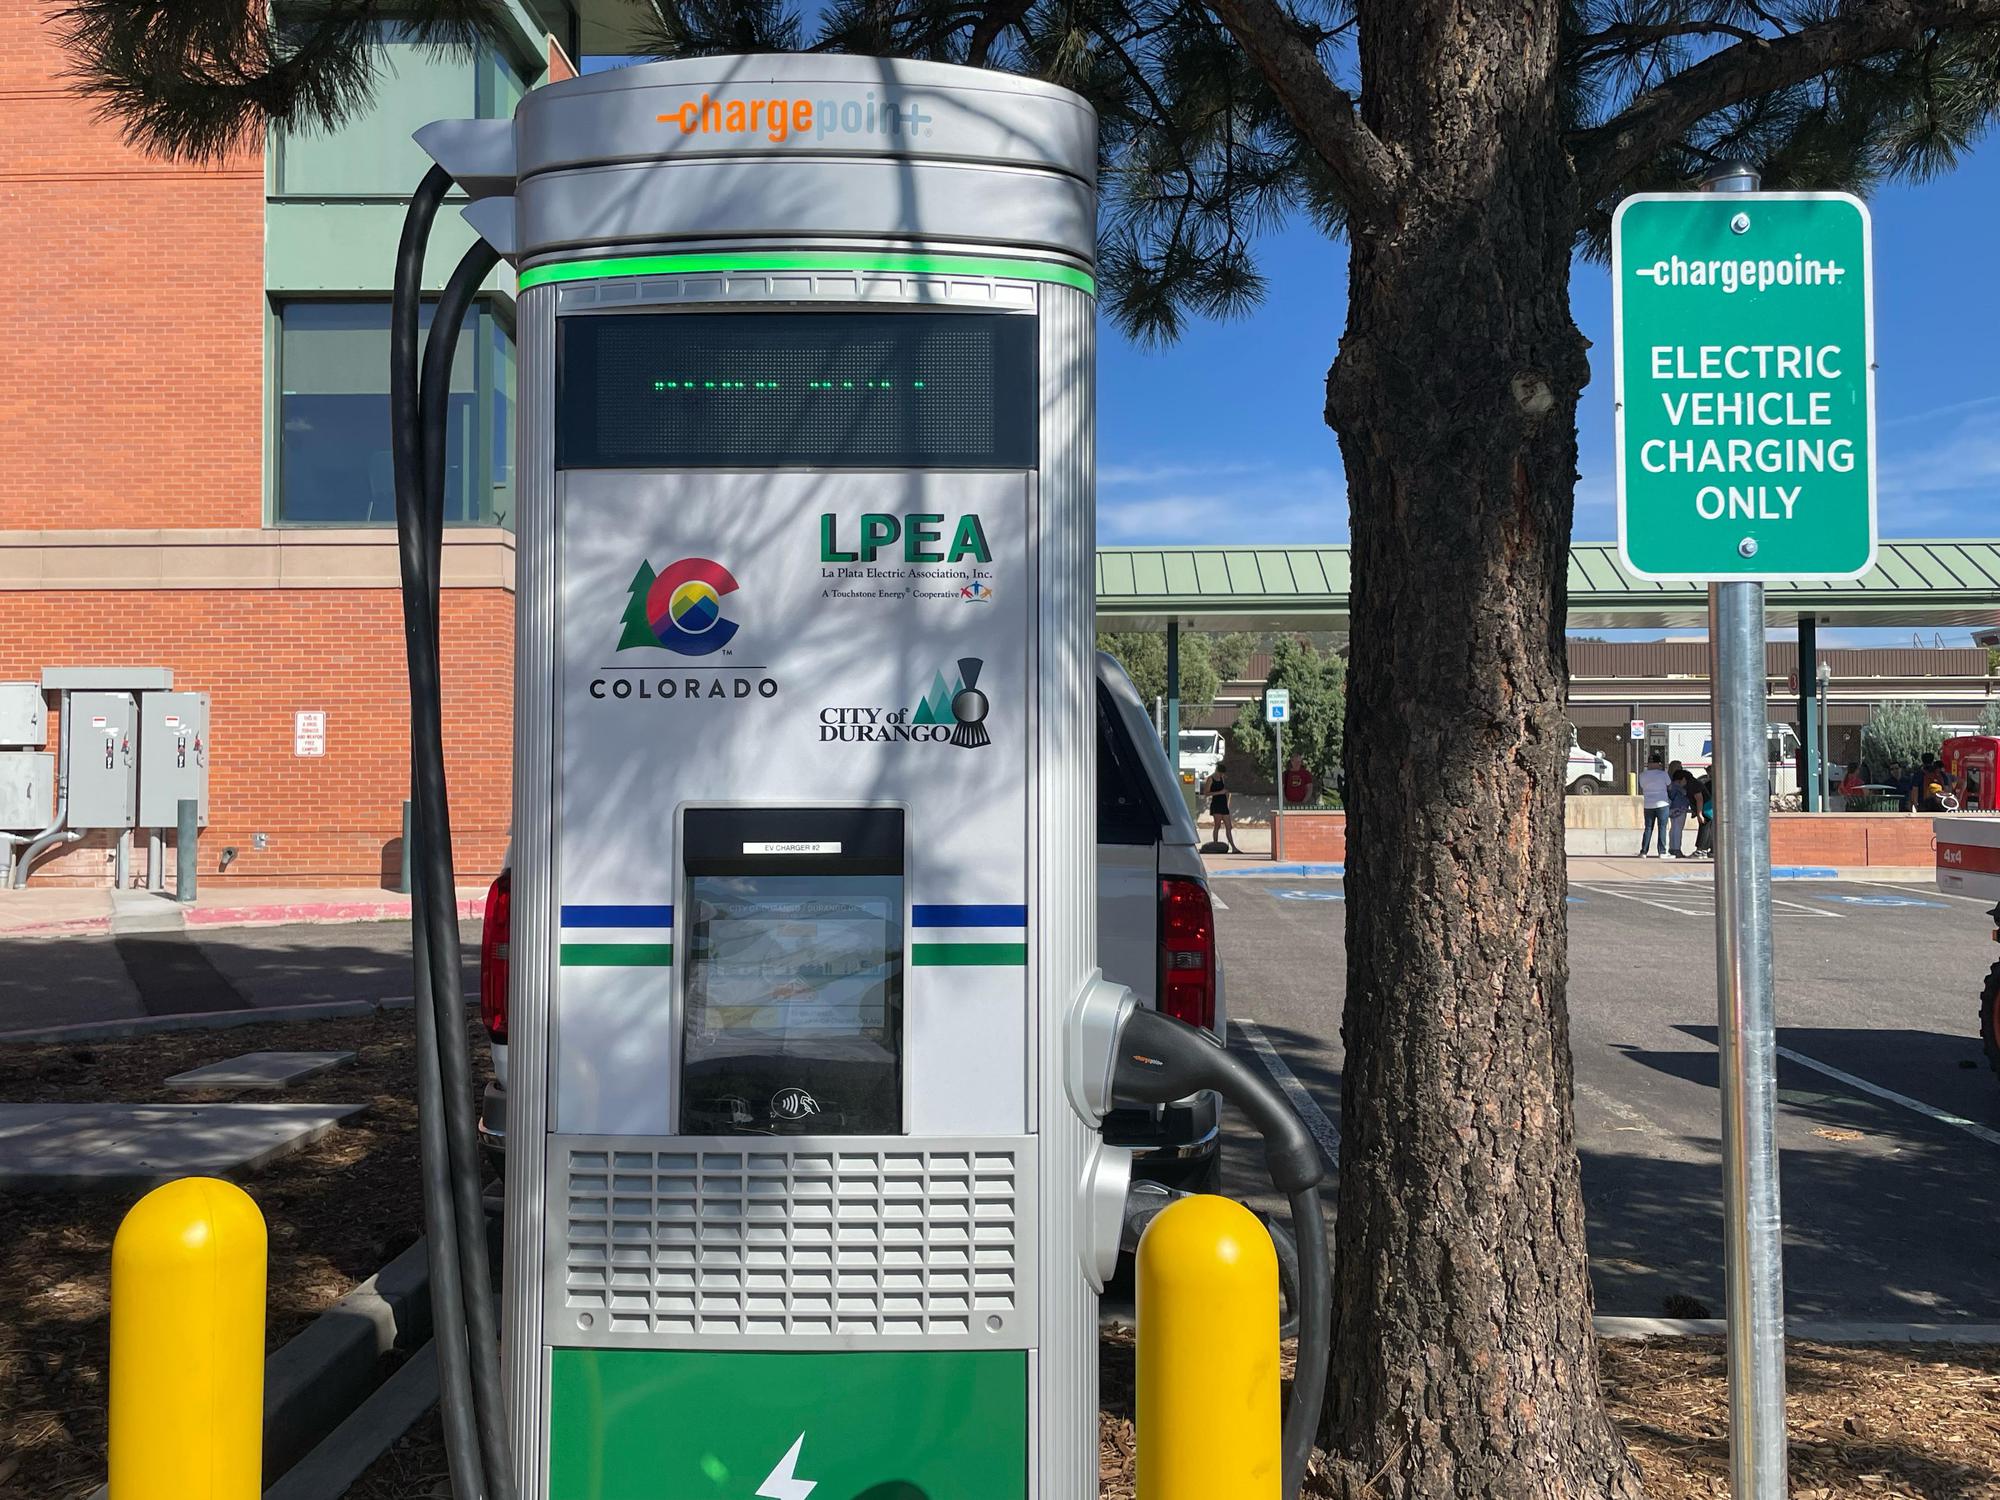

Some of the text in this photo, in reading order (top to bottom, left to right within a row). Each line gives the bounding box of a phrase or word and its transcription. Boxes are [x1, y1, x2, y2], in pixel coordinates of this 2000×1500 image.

[1651, 345, 1842, 379] ELECTRIC
[1661, 392, 1832, 426] VEHICLE
[1639, 438, 1856, 473] CHARGING
[1695, 485, 1802, 520] ONLY
[820, 513, 993, 563] LPEA
[821, 568, 993, 580] La Plata Electric Association, Inc.
[821, 589, 829, 598] A
[831, 588, 876, 598] Touchstone
[912, 589, 960, 600] Cooperative
[589, 678, 778, 700] COLORADO
[819, 707, 909, 725] CITY of
[818, 724, 951, 742] DURANGO
[764, 843, 821, 852] EV CHARGER #2
[1943, 848, 1962, 865] 4x4
